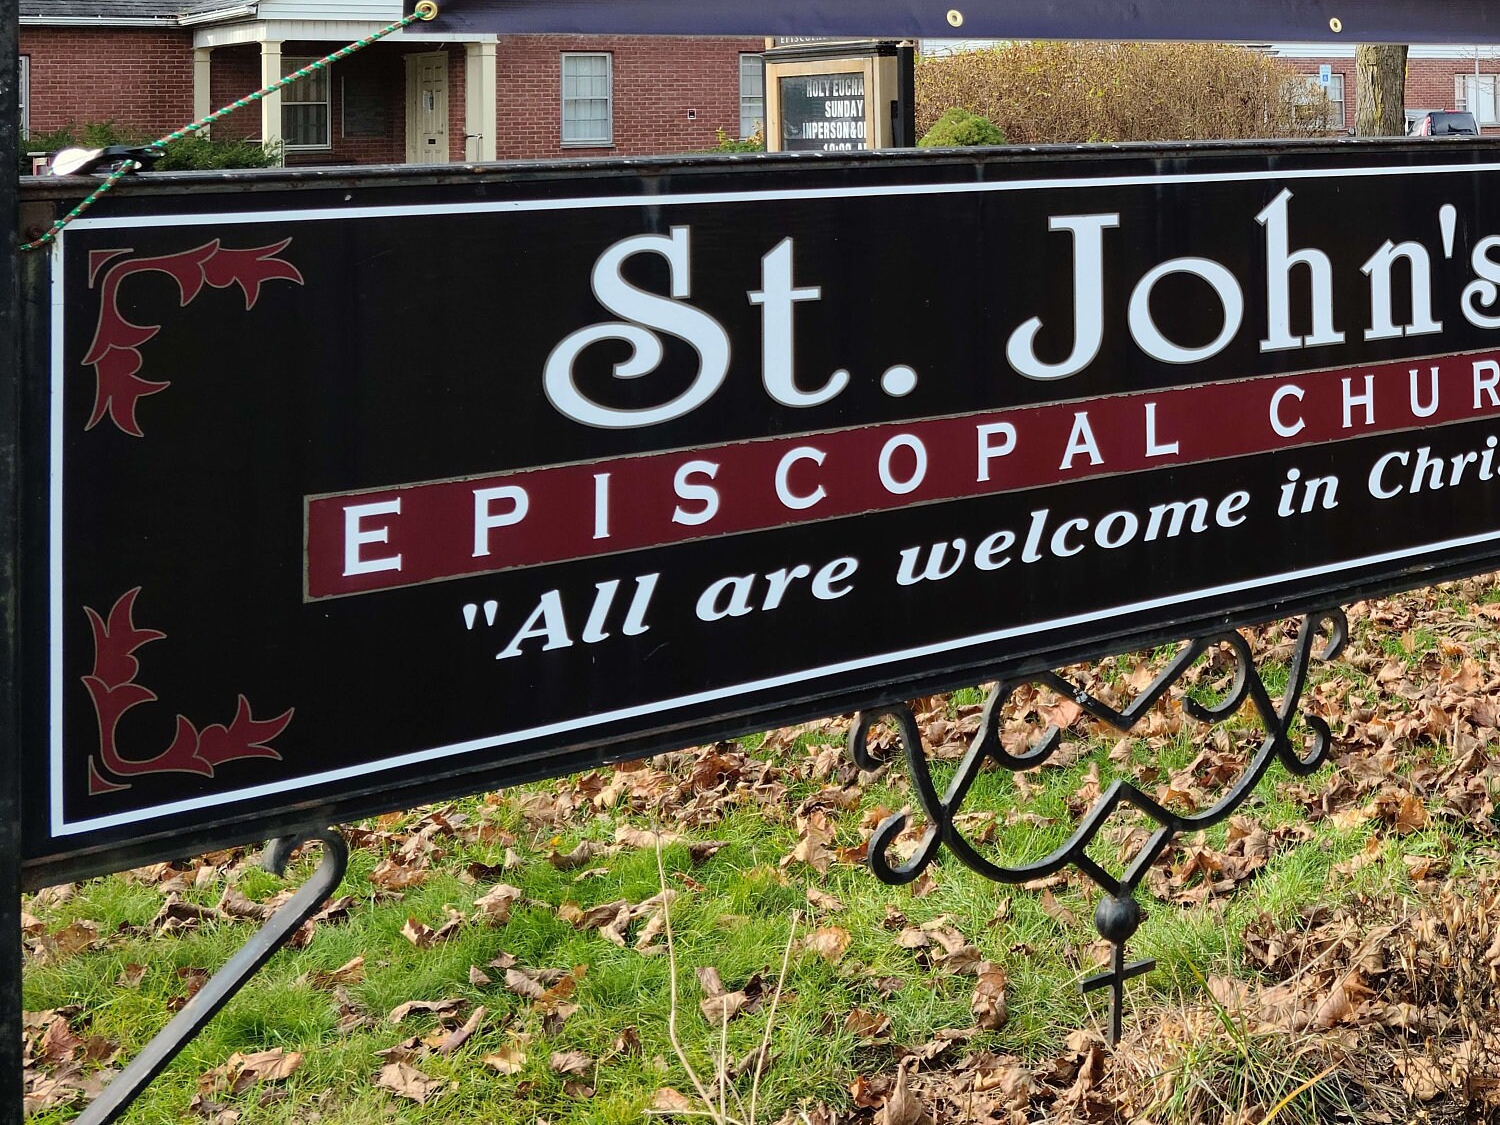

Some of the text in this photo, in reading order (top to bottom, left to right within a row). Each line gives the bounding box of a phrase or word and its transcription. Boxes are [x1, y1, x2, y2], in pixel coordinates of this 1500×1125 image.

[806, 79, 831, 98] HOLY
[825, 99, 863, 118] SUNDAY
[543, 224, 918, 428] St.
[340, 401, 1181, 578] EPISCOPAL
[461, 571, 661, 661] "All
[694, 556, 860, 623] are
[895, 489, 1251, 587] welcome
[1276, 466, 1340, 519] in
